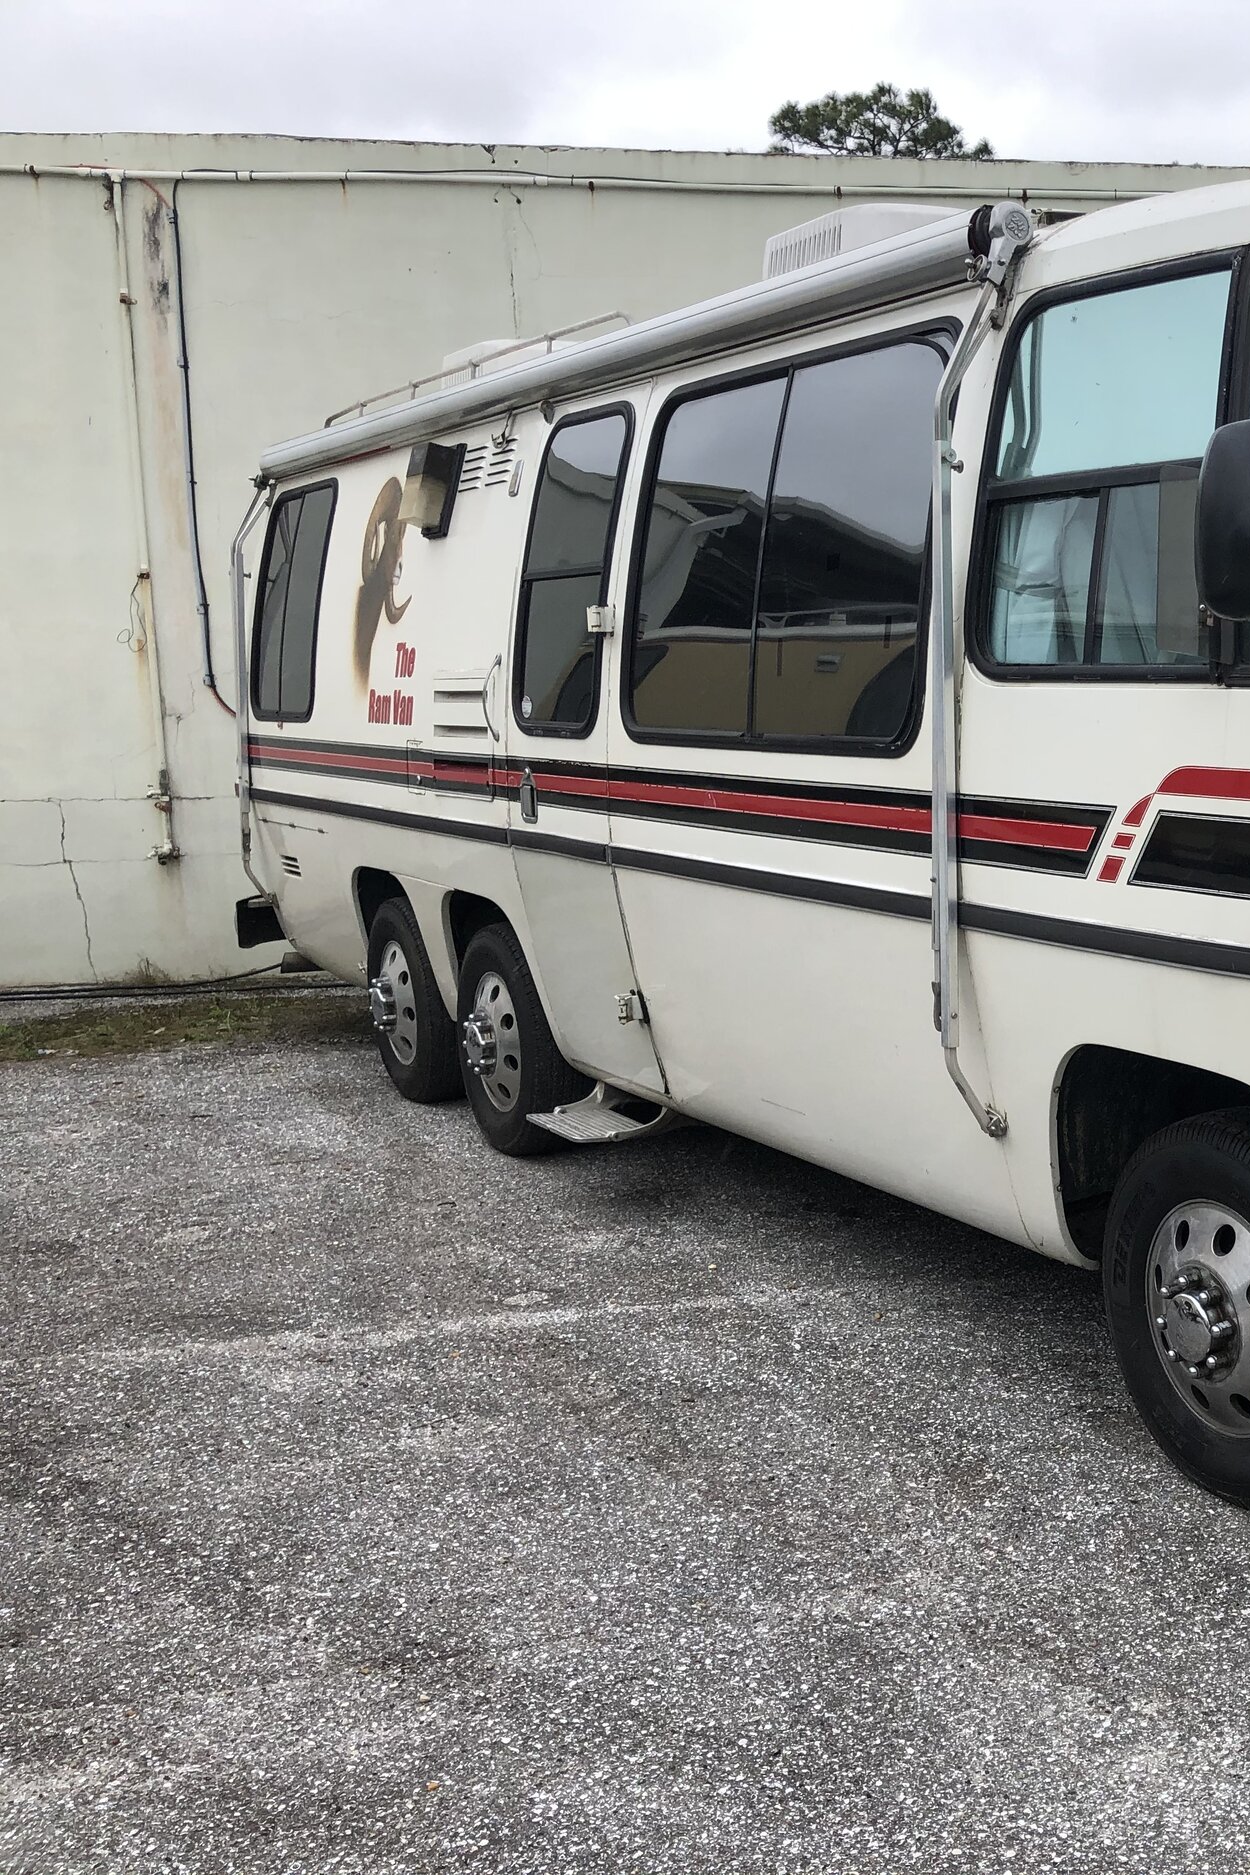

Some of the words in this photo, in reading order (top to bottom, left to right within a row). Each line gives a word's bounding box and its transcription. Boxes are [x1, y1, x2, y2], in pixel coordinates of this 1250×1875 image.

[394, 642, 416, 678] The
[368, 689, 391, 724] Ram
[393, 690, 414, 726] Van
